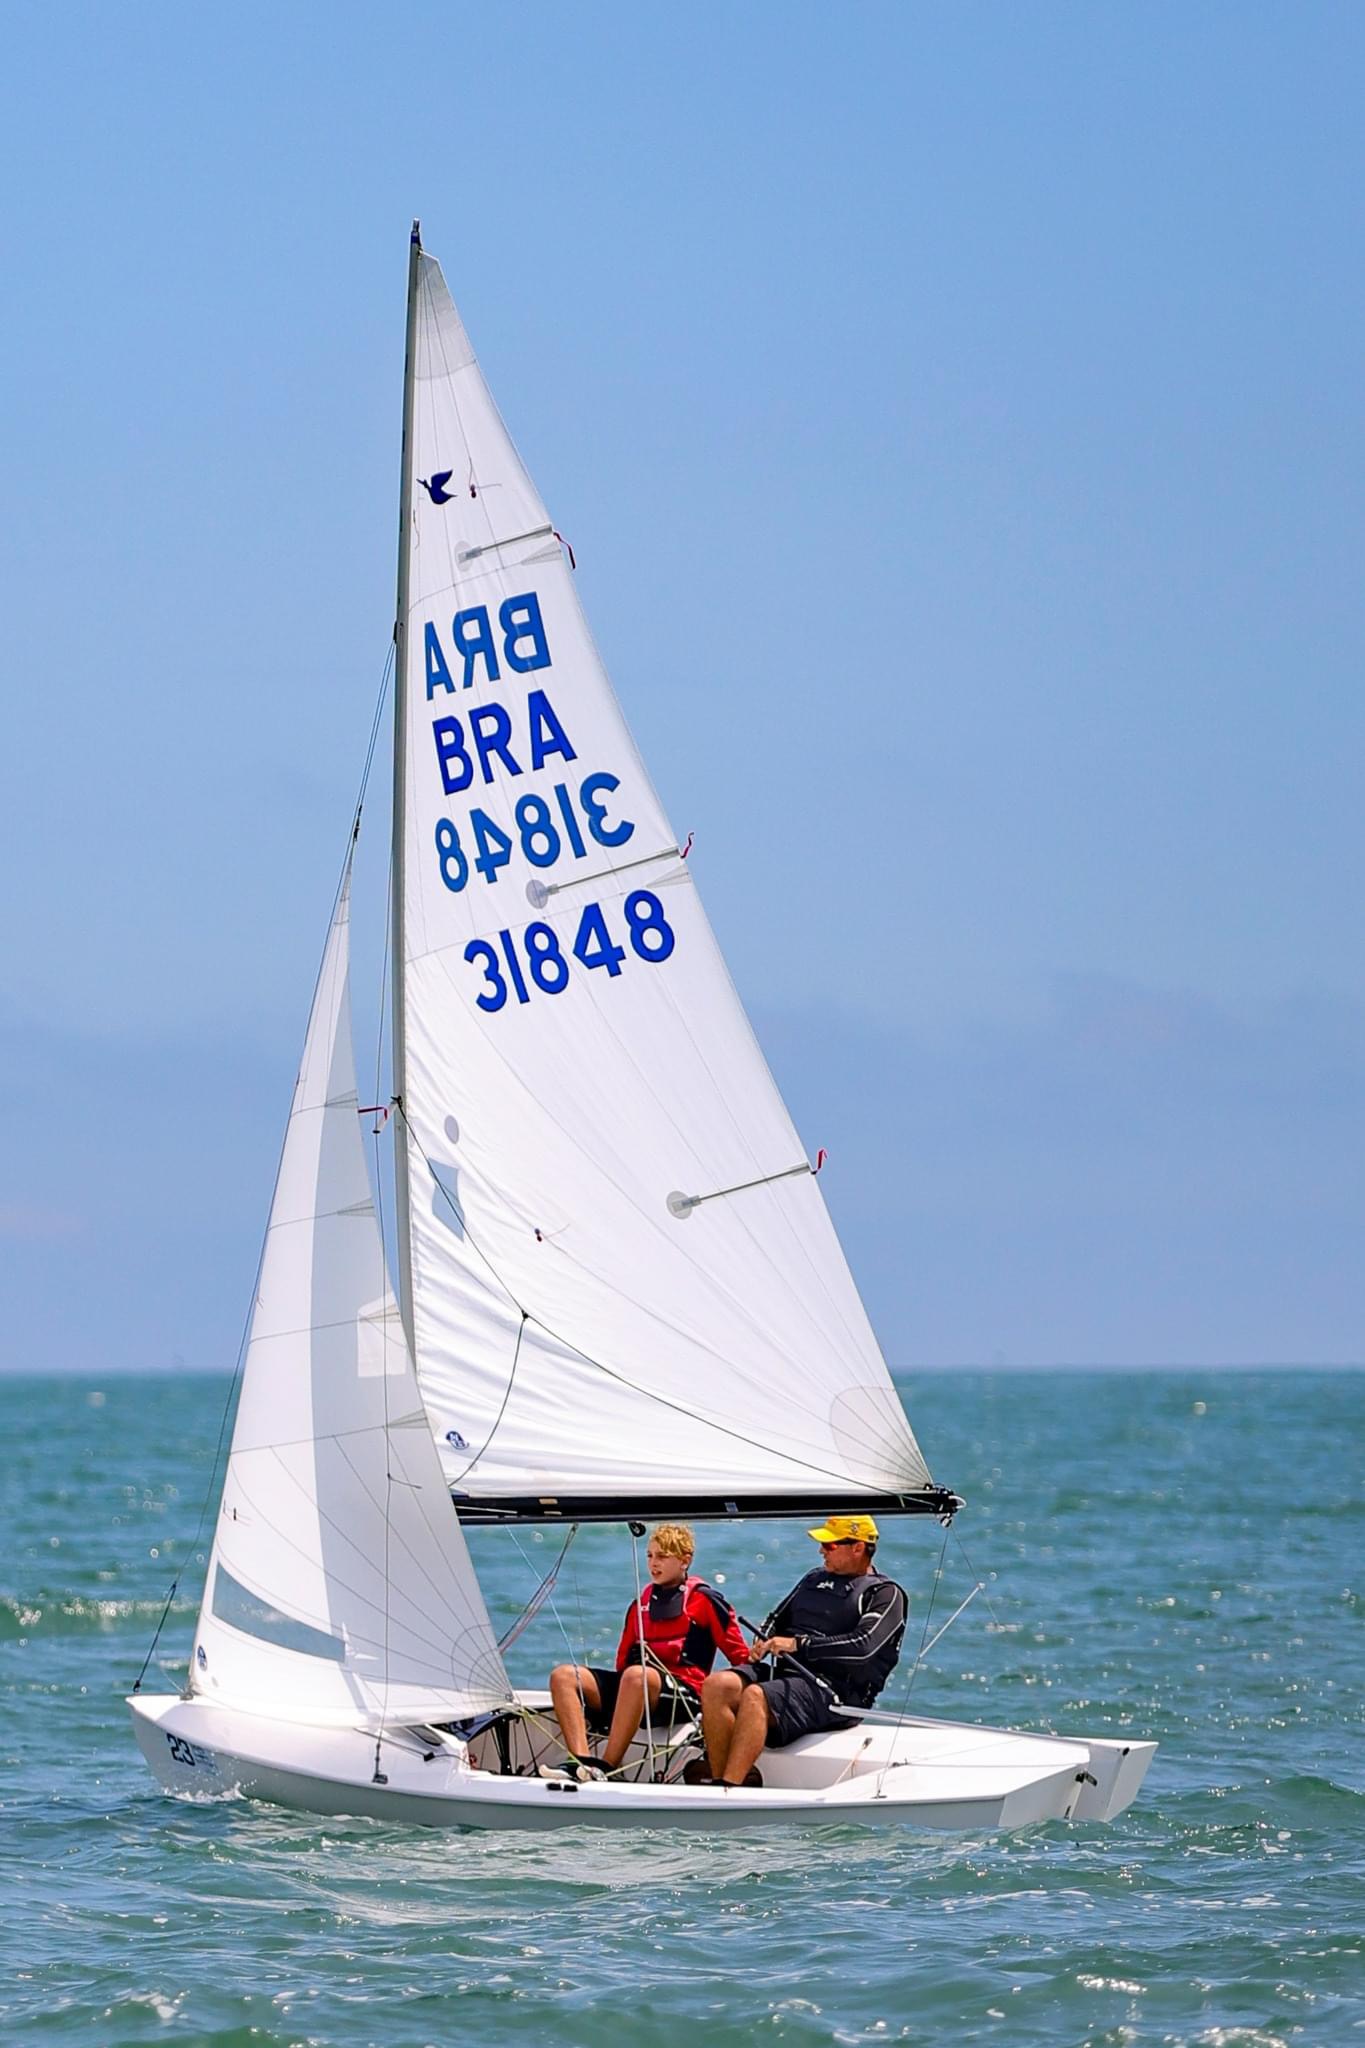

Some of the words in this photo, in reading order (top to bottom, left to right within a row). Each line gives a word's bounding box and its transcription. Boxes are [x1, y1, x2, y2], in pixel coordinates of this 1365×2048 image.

[431, 689, 577, 795] BRA
[463, 889, 676, 1013] 31848
[166, 1732, 196, 1767] 23
